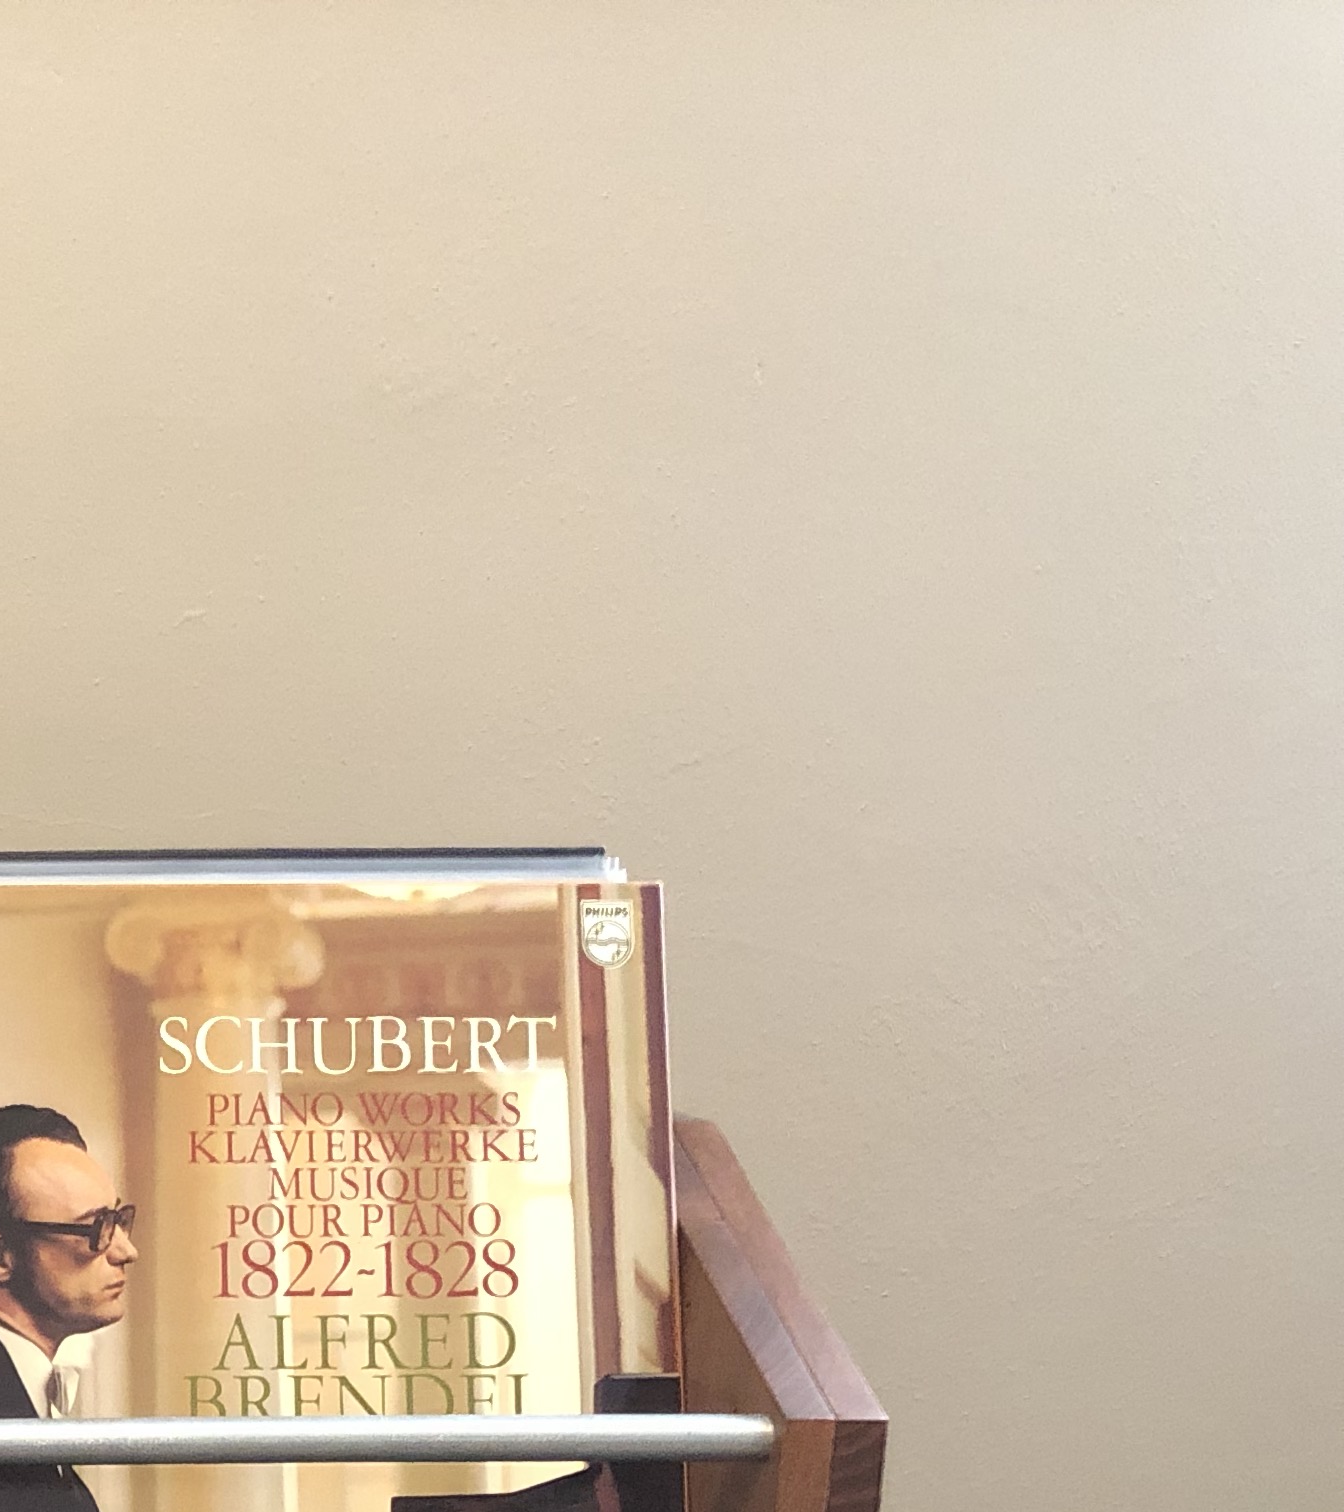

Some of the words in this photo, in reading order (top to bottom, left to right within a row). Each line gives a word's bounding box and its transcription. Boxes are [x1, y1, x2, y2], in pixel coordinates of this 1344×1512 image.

[584, 906, 629, 918] PHILIPS
[158, 1014, 557, 1076] SCHUBERT
[206, 1091, 344, 1128] PIANO
[358, 1091, 522, 1127] WORKS
[188, 1128, 540, 1164] KLAVIERWERKE
[267, 1165, 469, 1204] MUSIQUE
[226, 1203, 349, 1239] POUR
[360, 1202, 502, 1238] PIANO
[211, 1238, 520, 1300] 1822-1828
[211, 1311, 518, 1371] ALFRED
